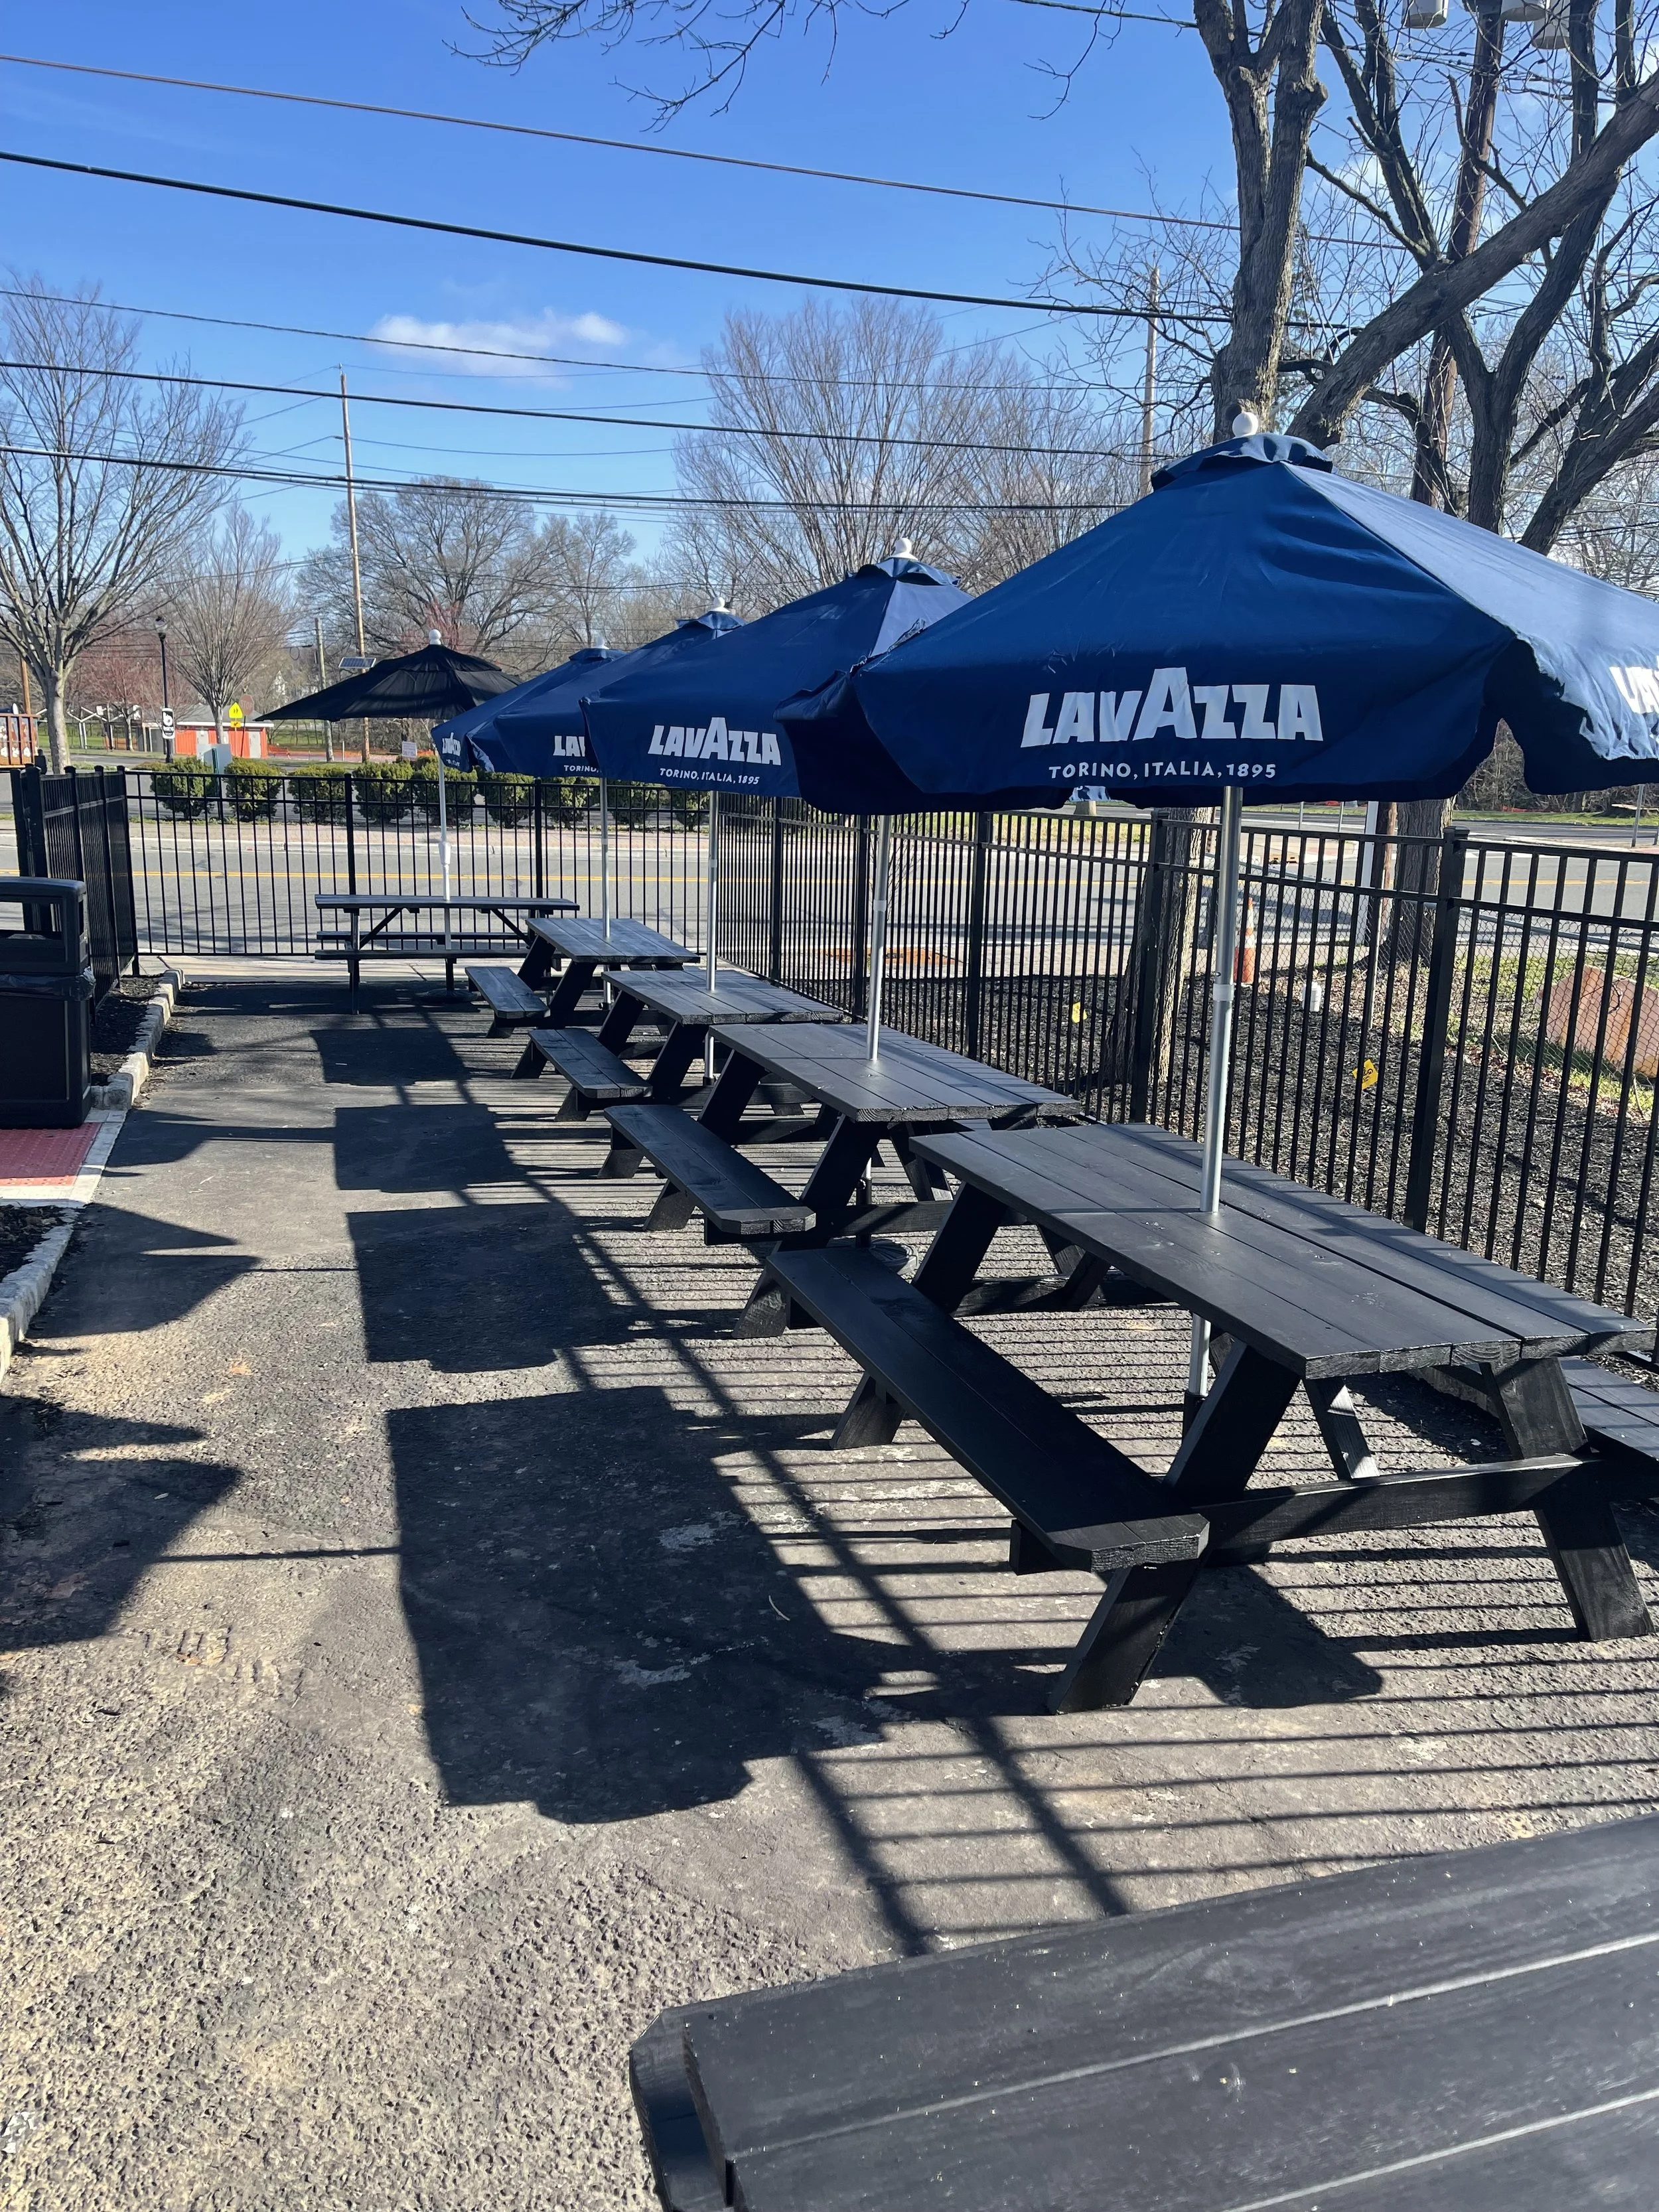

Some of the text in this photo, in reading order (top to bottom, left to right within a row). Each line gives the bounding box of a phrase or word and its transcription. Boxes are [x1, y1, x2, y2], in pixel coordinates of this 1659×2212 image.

[1020, 666, 1324, 748] LAVAZZA
[647, 717, 782, 766] LAVAZZA
[660, 768, 760, 784] TORINO, ITALIA, 1895
[1048, 761, 1276, 780] TORINO, ITALIA, 1895
